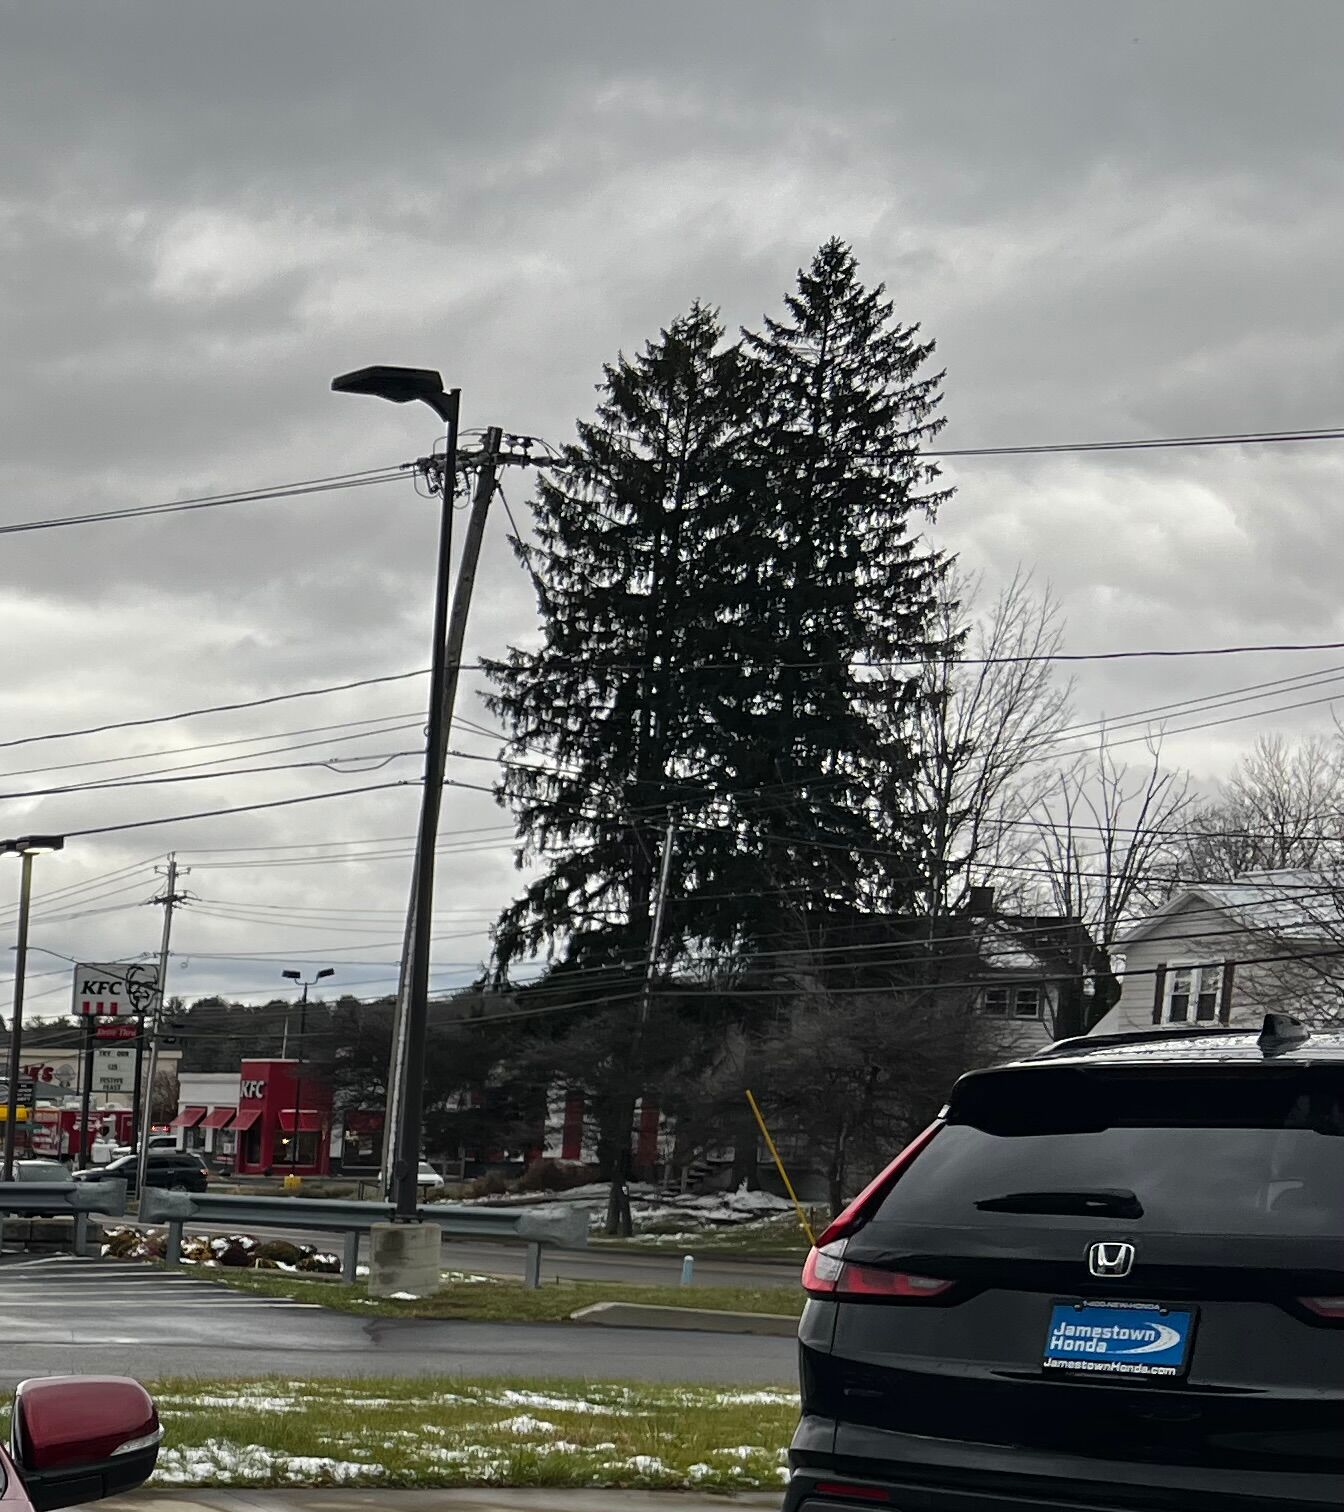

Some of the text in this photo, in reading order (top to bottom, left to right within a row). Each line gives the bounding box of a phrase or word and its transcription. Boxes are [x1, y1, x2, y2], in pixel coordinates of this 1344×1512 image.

[80, 980, 122, 995] KFC
[240, 1080, 264, 1099] KFC
[1054, 1322, 1156, 1341] Jamestown
[1050, 1336, 1107, 1353] Honda
[1043, 1357, 1176, 1376] JamestownHonda.com
